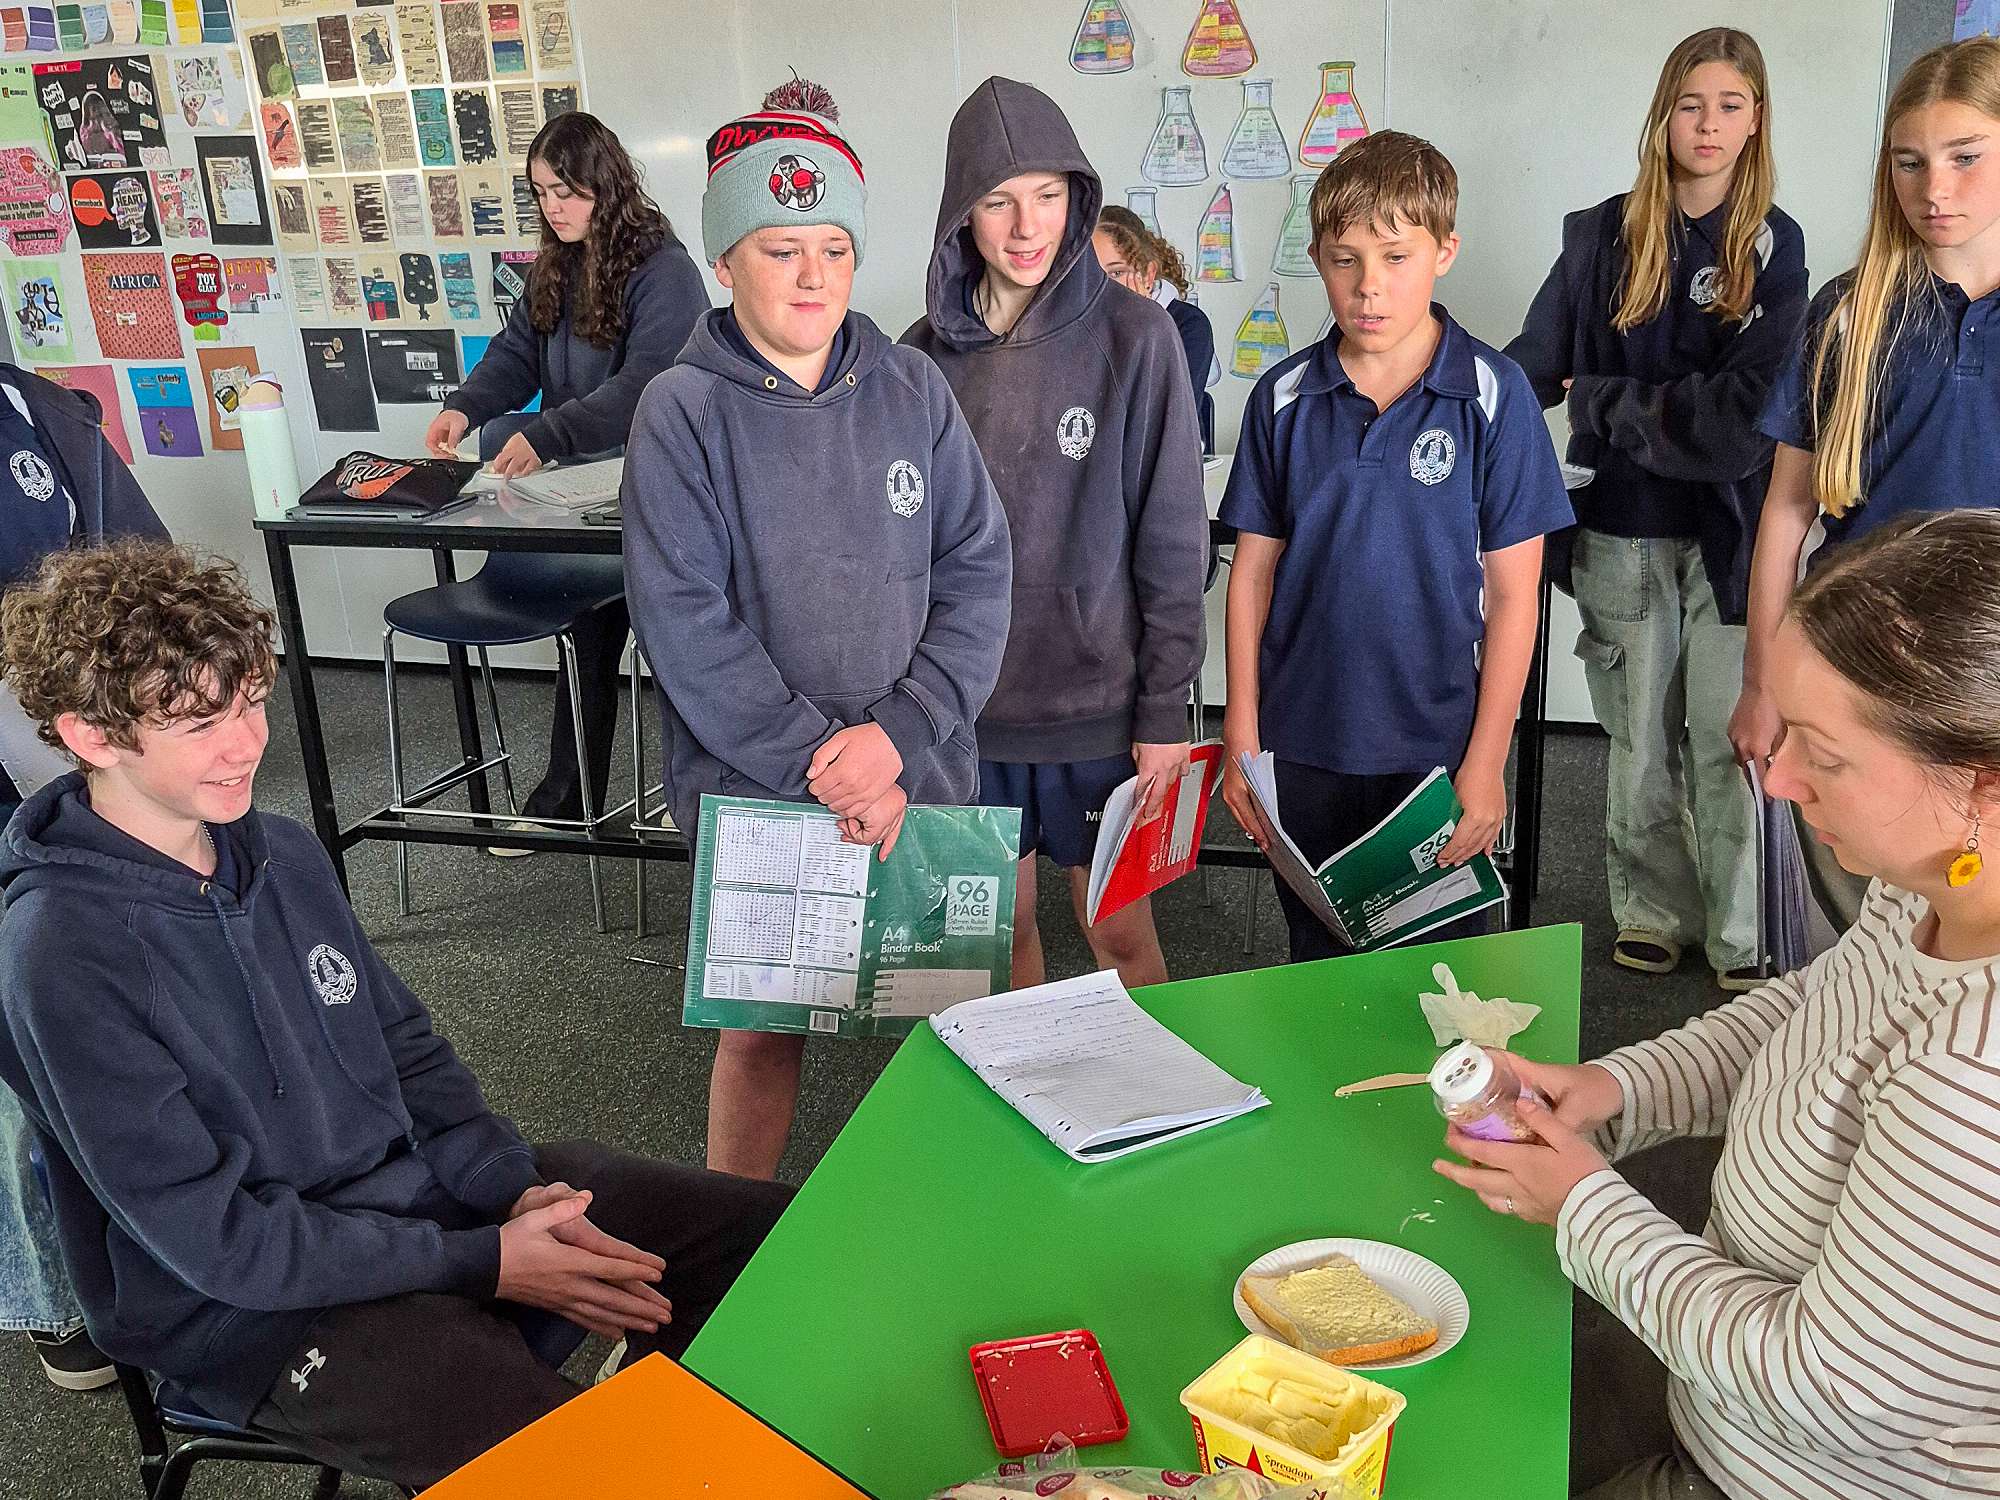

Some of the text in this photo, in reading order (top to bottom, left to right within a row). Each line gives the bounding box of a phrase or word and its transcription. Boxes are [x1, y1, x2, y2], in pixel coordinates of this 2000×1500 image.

[74, 199, 102, 207] Comeback
[116, 194, 143, 207] HEART
[110, 273, 160, 289] AFRICA
[196, 272, 216, 286] TOY
[197, 285, 218, 293] GIANT
[1419, 832, 1451, 855] 96
[956, 879, 990, 903] 96
[952, 903, 990, 917] PAGE
[881, 926, 904, 942] A4
[880, 941, 941, 954] Binder Book
[1264, 1453, 1314, 1481] Spreadabl
